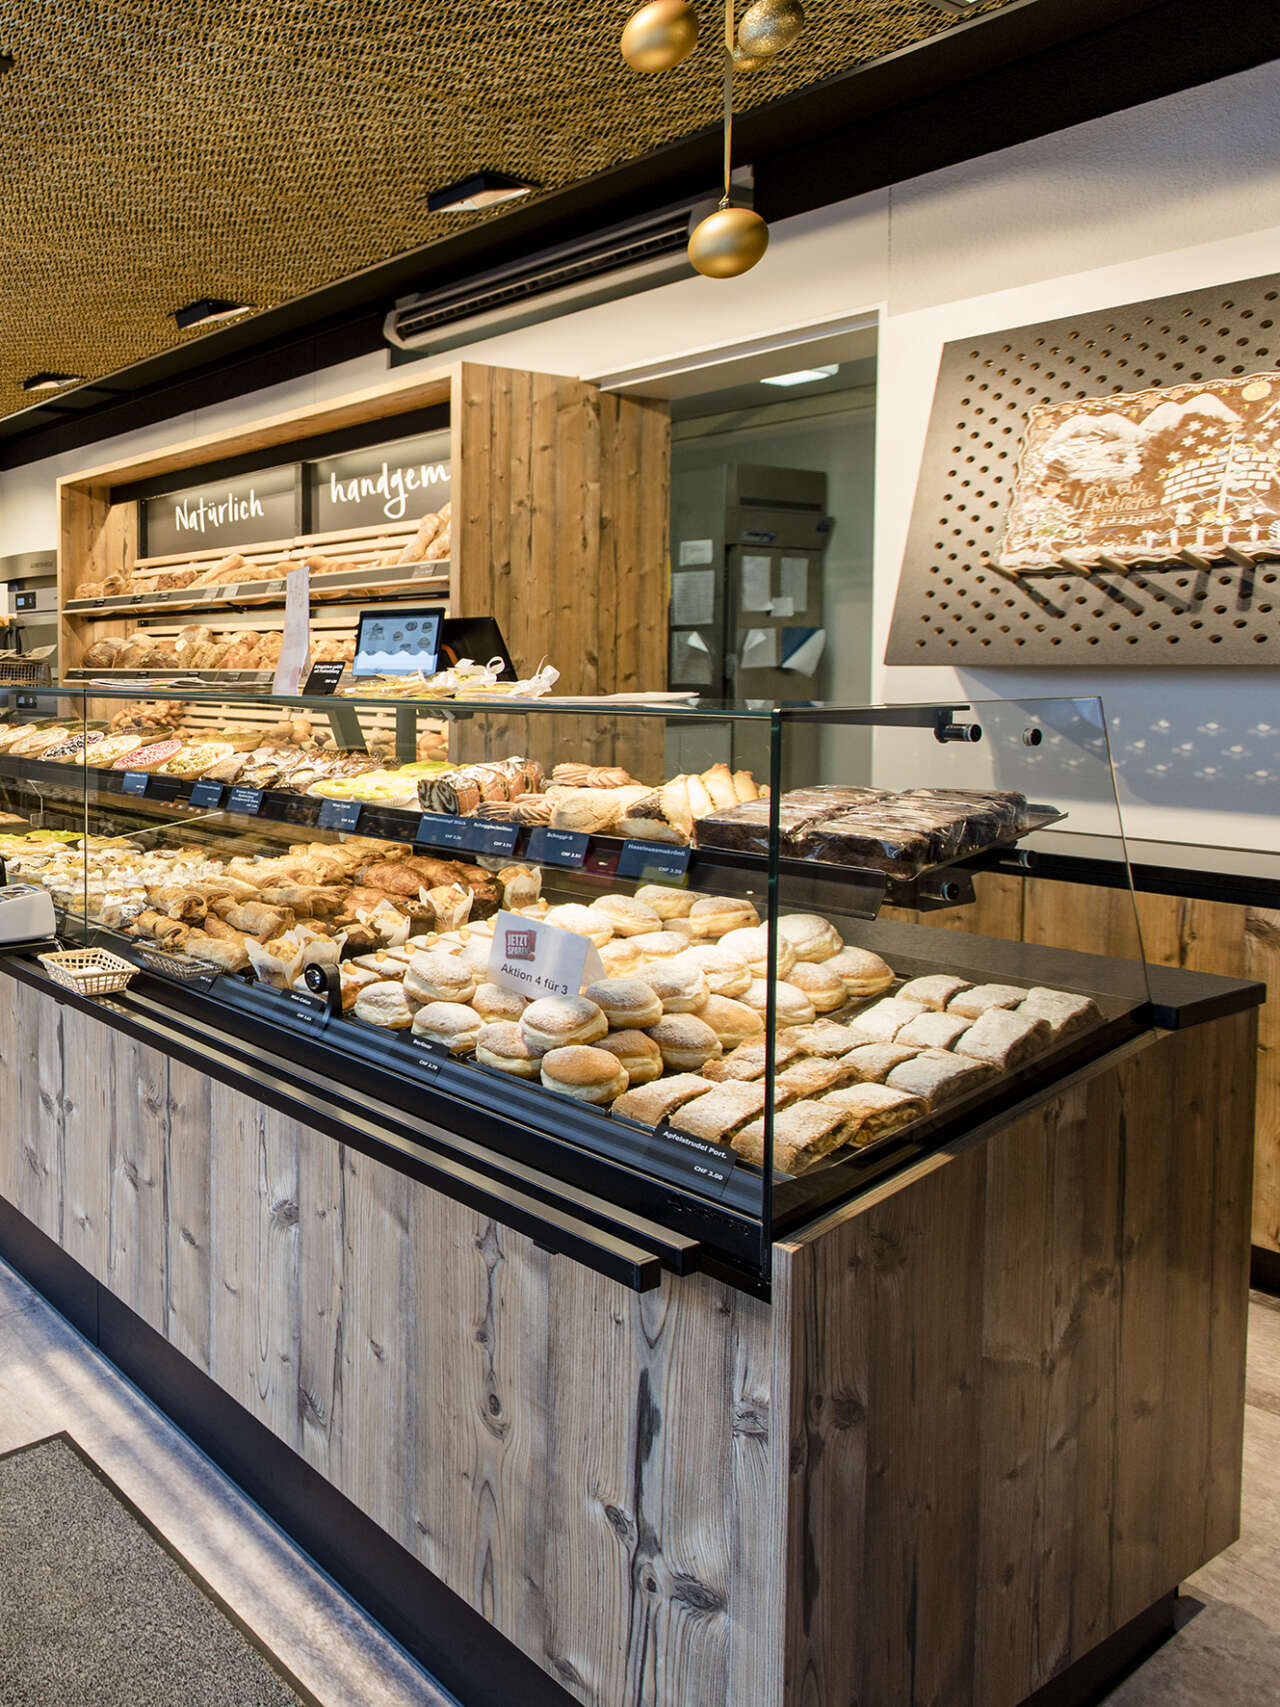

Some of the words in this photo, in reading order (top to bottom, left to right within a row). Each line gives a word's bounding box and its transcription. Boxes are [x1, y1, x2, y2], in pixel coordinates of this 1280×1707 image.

[175, 489, 265, 533] Natürlich
[500, 963, 533, 982] Aktion
[535, 975, 542, 985] 4
[544, 978, 559, 991] für
[561, 984, 569, 995] 3
[663, 1131, 708, 1151] Apfelstrudel
[708, 1147, 727, 1159] Port.
[693, 1165, 708, 1175] CHF
